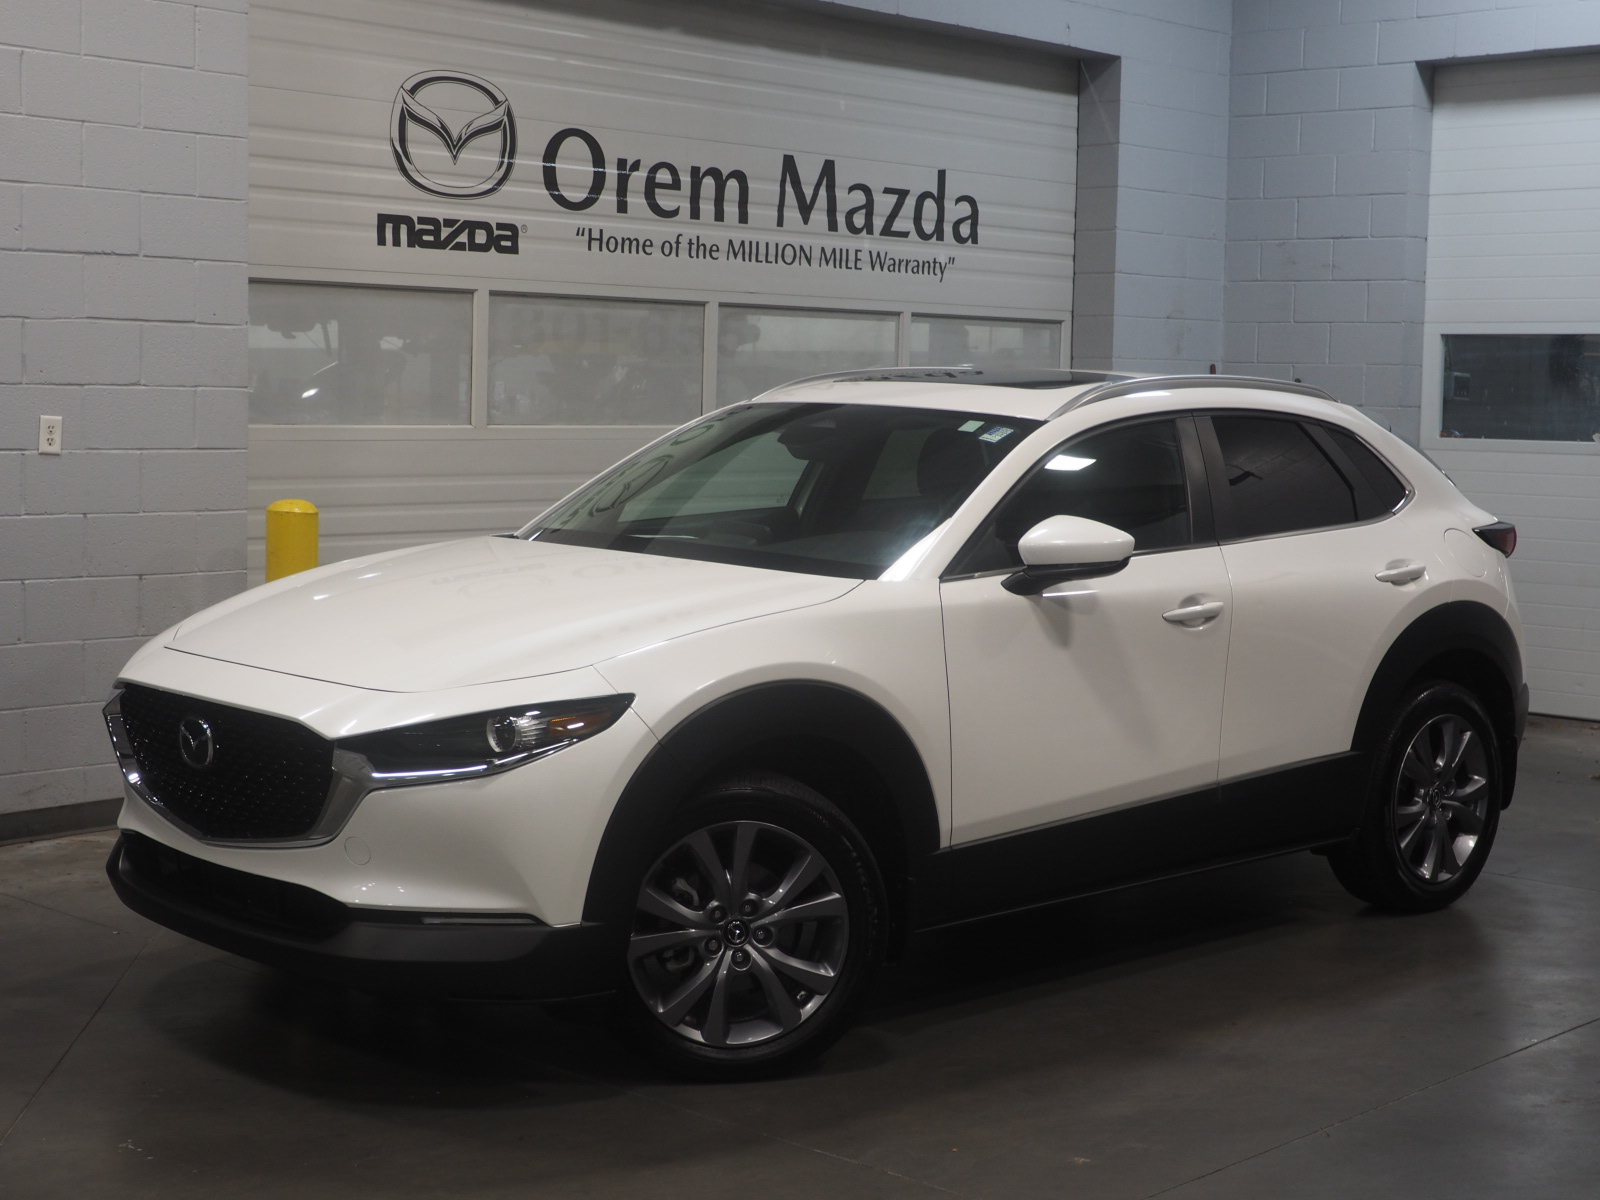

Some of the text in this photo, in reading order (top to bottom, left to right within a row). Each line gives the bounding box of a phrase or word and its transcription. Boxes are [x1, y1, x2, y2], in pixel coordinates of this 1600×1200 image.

[542, 127, 979, 245] Orem Mazda
[661, 233, 683, 258] of
[687, 235, 720, 260] the
[726, 238, 813, 267] MILLION
[818, 246, 863, 271] MILE
